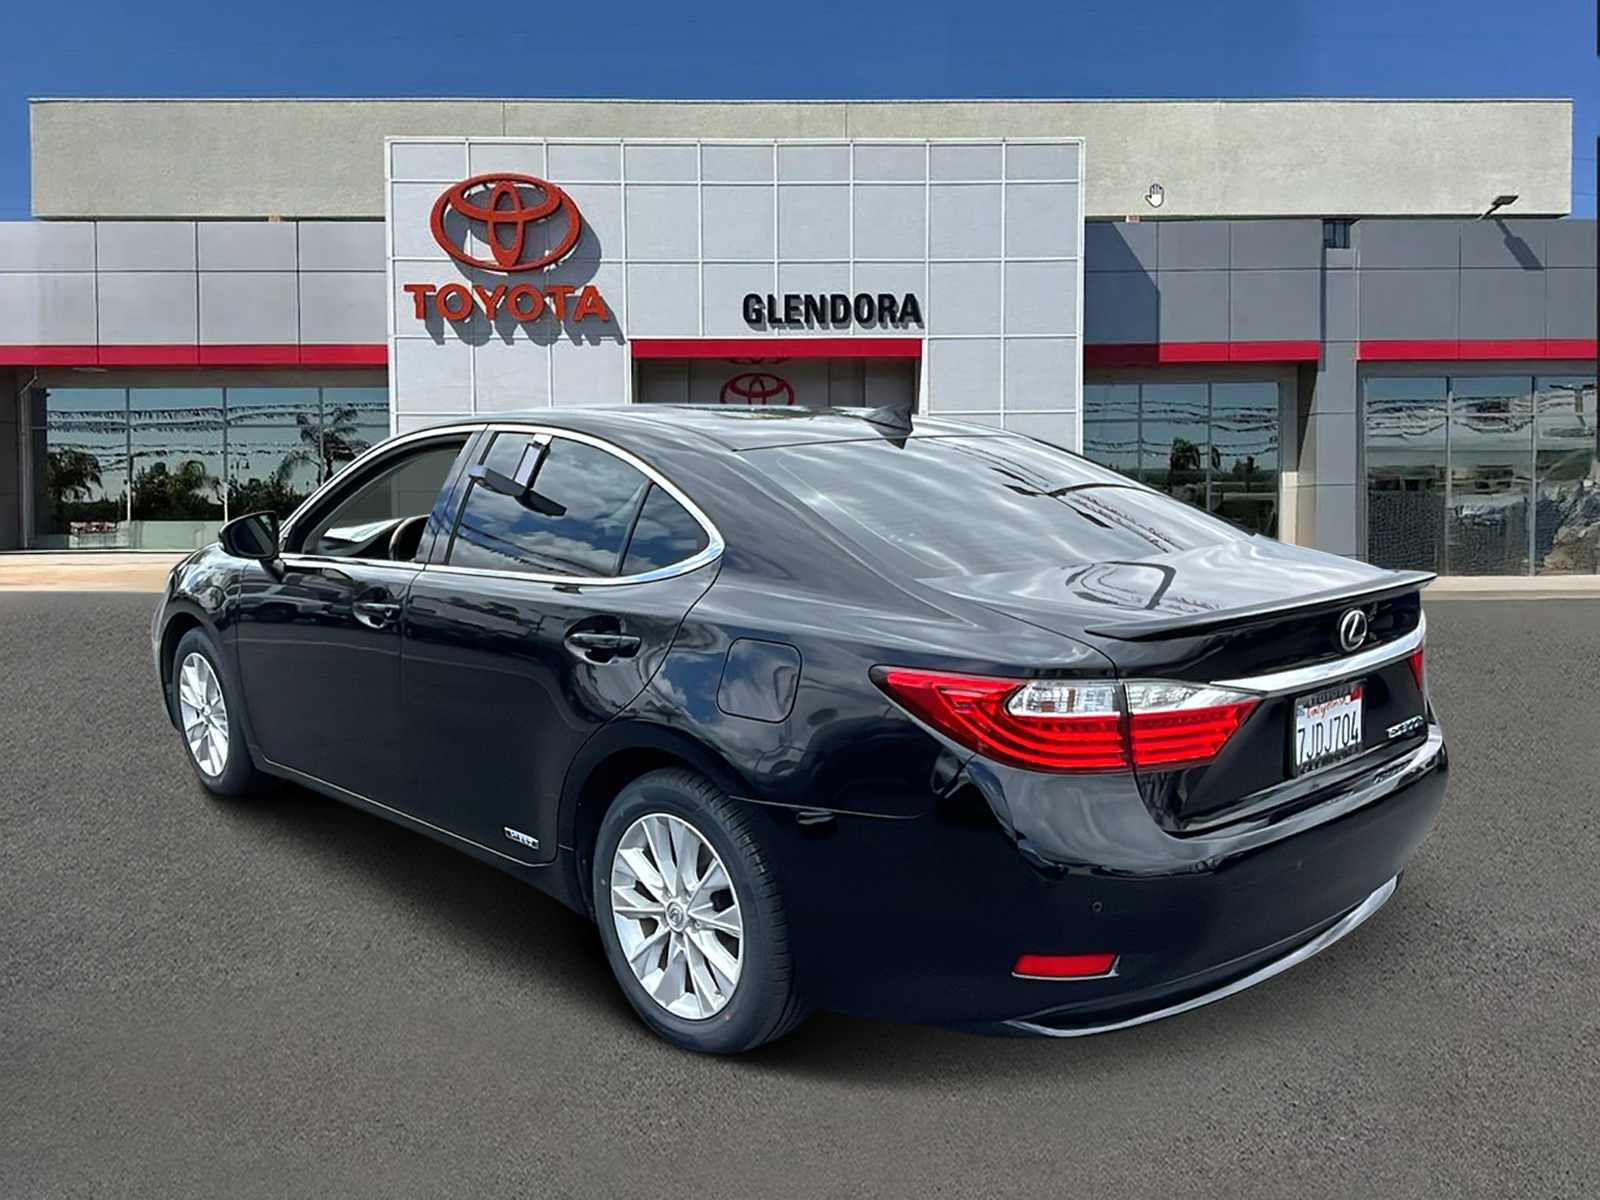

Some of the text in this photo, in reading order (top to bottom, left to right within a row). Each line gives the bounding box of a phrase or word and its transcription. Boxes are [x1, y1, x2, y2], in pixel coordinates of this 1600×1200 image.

[404, 283, 609, 321] TOYOTA
[743, 293, 922, 324] GLENDORA
[1297, 710, 1359, 764] 7JDJ704
